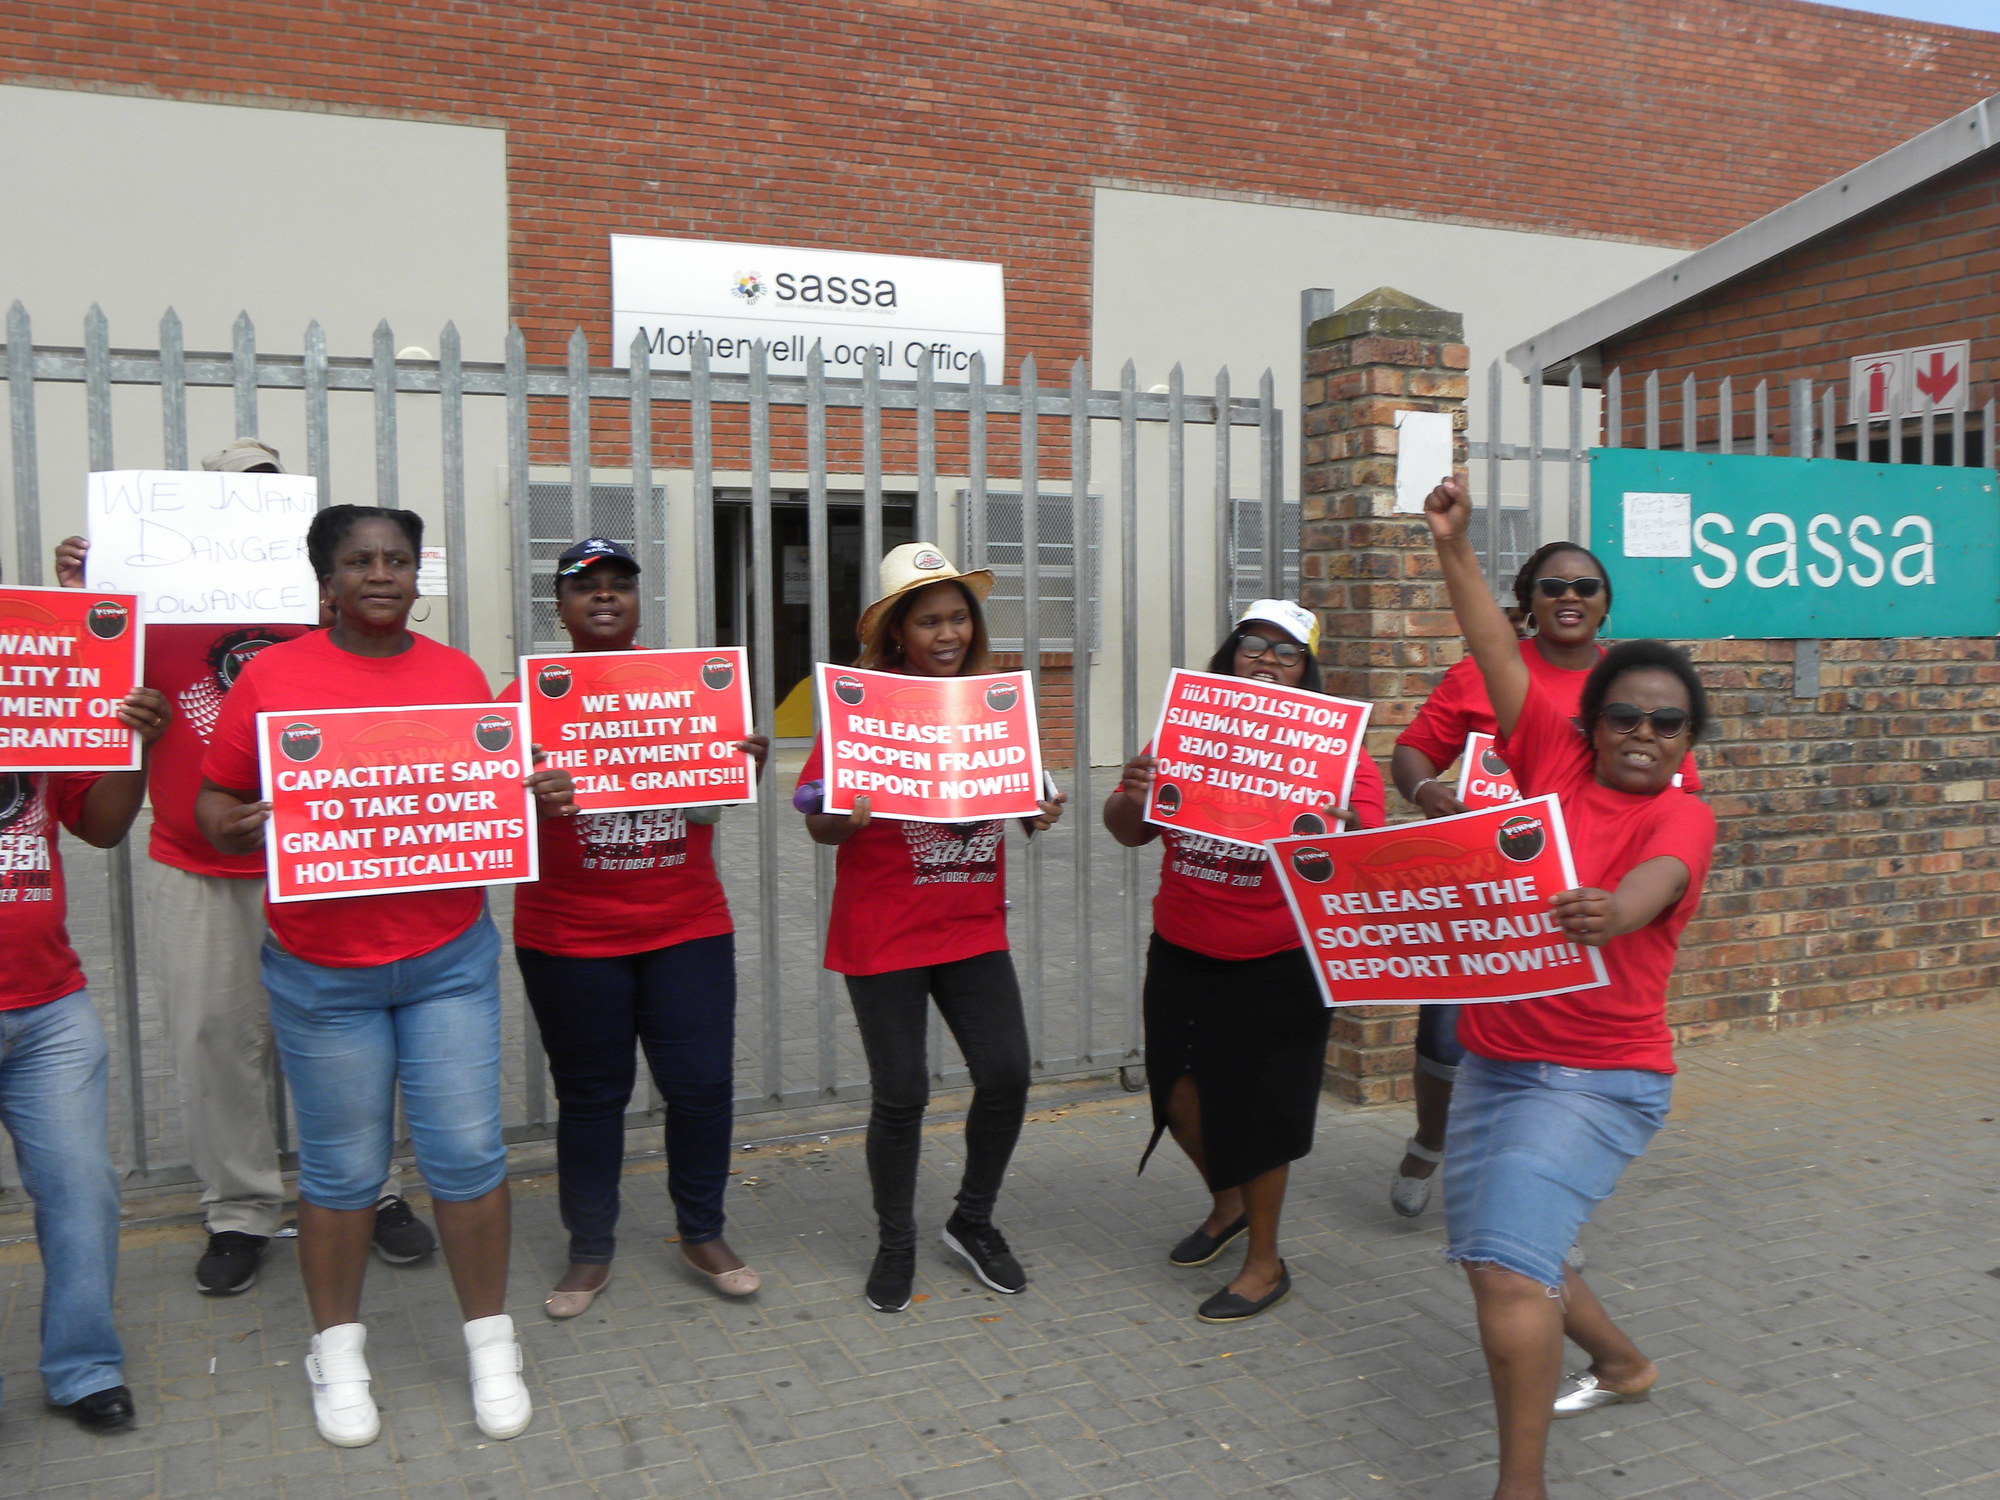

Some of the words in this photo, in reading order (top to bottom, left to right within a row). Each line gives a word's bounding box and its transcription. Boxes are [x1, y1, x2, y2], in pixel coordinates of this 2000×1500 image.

[775, 273, 898, 308] sassa
[101, 471, 185, 514] WE
[1692, 512, 1936, 589] sassa
[97, 581, 306, 614] OWANCE
[0, 634, 77, 656] WANT
[66, 667, 100, 688] IN
[0, 696, 82, 718] MENT
[88, 697, 124, 719] OF
[582, 694, 620, 713] WE
[625, 690, 694, 711] WANT
[1181, 683, 1348, 730] HOLISTICALLY!!!
[561, 717, 684, 741] STABILITY
[689, 716, 717, 734] IN
[848, 714, 952, 744] RELEASE
[957, 721, 1008, 743] THE
[1167, 707, 1268, 741] PAYMENTS
[545, 750, 588, 769] THE
[594, 743, 703, 766] PAYMENT
[709, 741, 738, 759] OF
[837, 740, 932, 771] SOCPEN
[938, 746, 1026, 772] FRAUD
[1178, 734, 1228, 760] OVER
[1271, 727, 1348, 756] GRANT
[1157, 757, 1205, 782] SAPO
[1230, 745, 1284, 772] TAKE
[1289, 757, 1319, 779] TO
[277, 763, 445, 792] CAPACITATE
[451, 759, 520, 782] SAPO
[571, 774, 626, 794] CIAL
[631, 767, 744, 791] GRANTS!!!
[837, 768, 933, 798] REPORT
[939, 772, 1030, 799] NOW!!!
[1207, 771, 1336, 807] CAPACITATE
[305, 800, 344, 821] TO
[350, 795, 420, 818] TAKE
[426, 790, 498, 814] OVER
[282, 828, 376, 854] GRANT
[383, 818, 524, 847] PAYMENTS
[295, 849, 513, 885] HOLISTICALLY!!!
[1321, 886, 1462, 916] RELEASE
[1467, 876, 1539, 906] THE
[1315, 922, 1445, 950] SOCPEN
[1326, 954, 1450, 981] REPORT
[1458, 942, 1582, 976] NOW!!!
